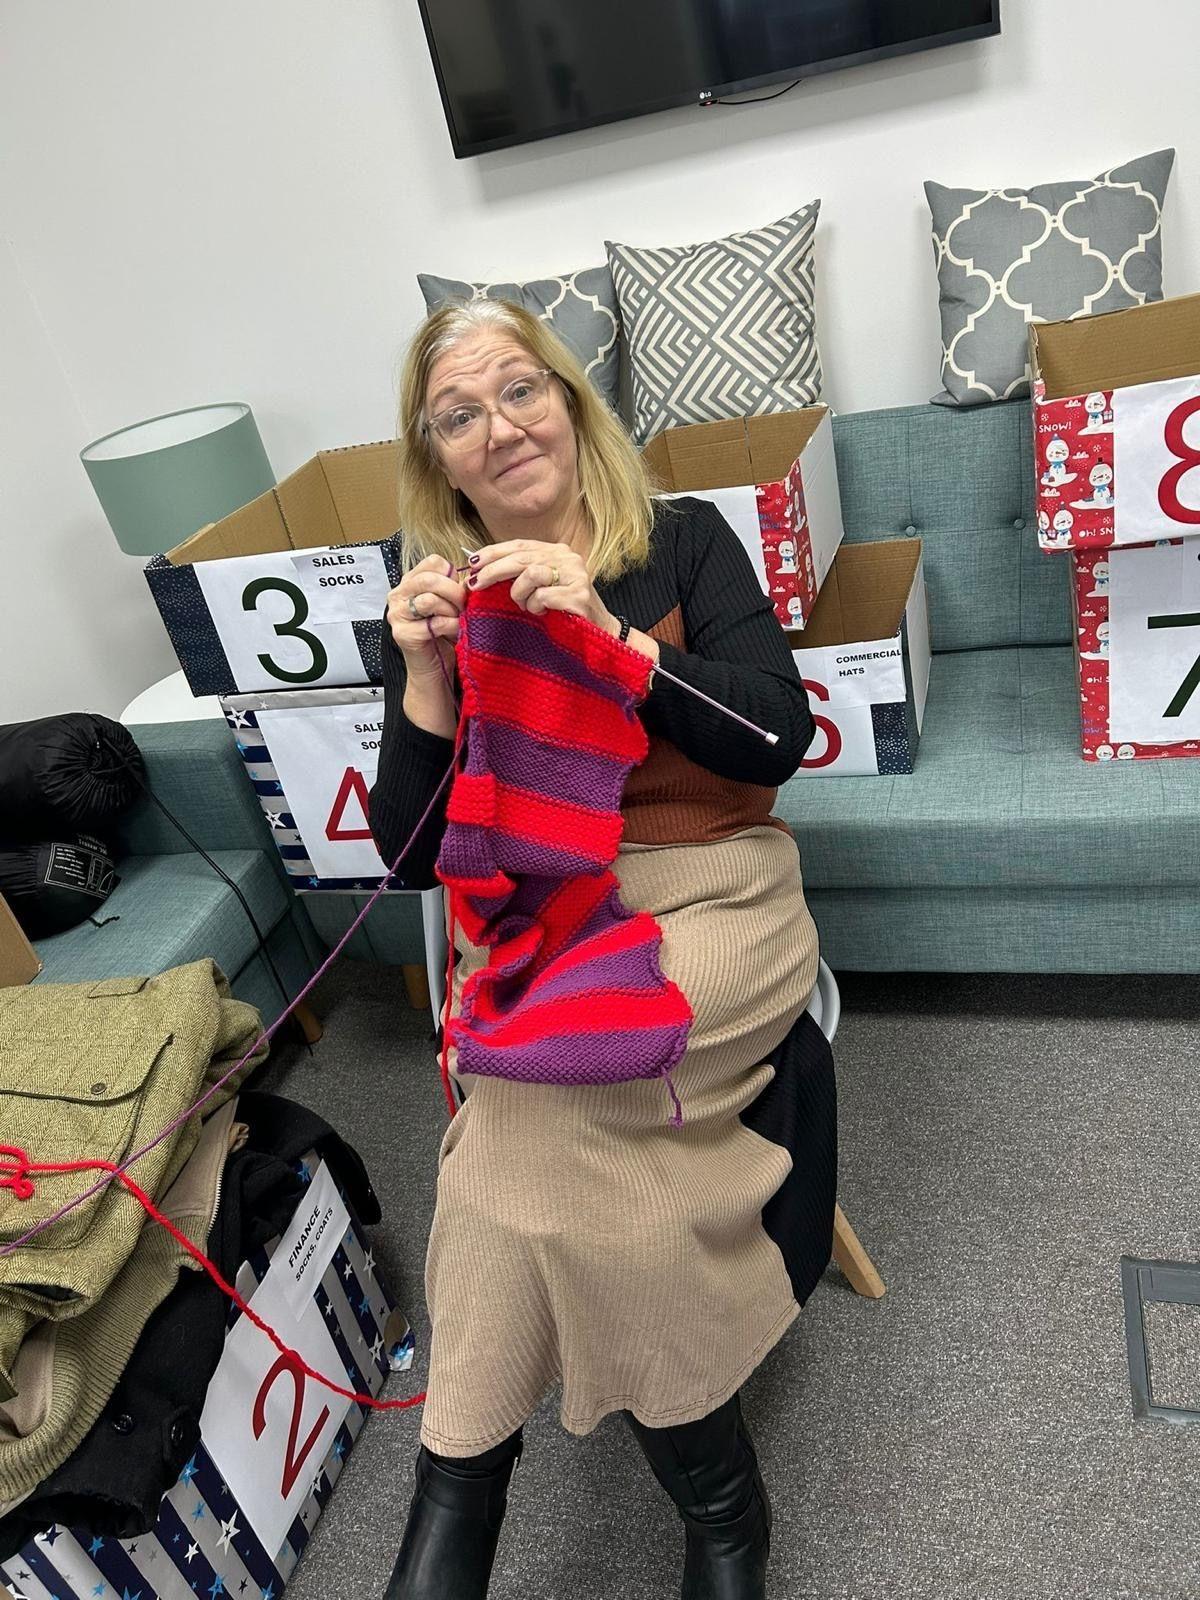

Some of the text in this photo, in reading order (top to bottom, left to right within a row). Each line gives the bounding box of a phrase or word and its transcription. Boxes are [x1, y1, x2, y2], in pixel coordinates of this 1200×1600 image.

[1038, 421, 1072, 433] SNOW!
[312, 554, 355, 568] SALES
[319, 574, 365, 587] SOCKS
[241, 576, 329, 684] 3
[836, 649, 901, 664] COMMERCIAL
[839, 667, 865, 677] HATS
[1147, 611, 1200, 718] 7
[354, 722, 384, 733] SALE
[361, 740, 383, 750] SOC
[325, 766, 381, 856] 4
[288, 1205, 321, 1268] FINANCE
[296, 1207, 333, 1282] SOCKS, COATS
[253, 1349, 330, 1501] 2
